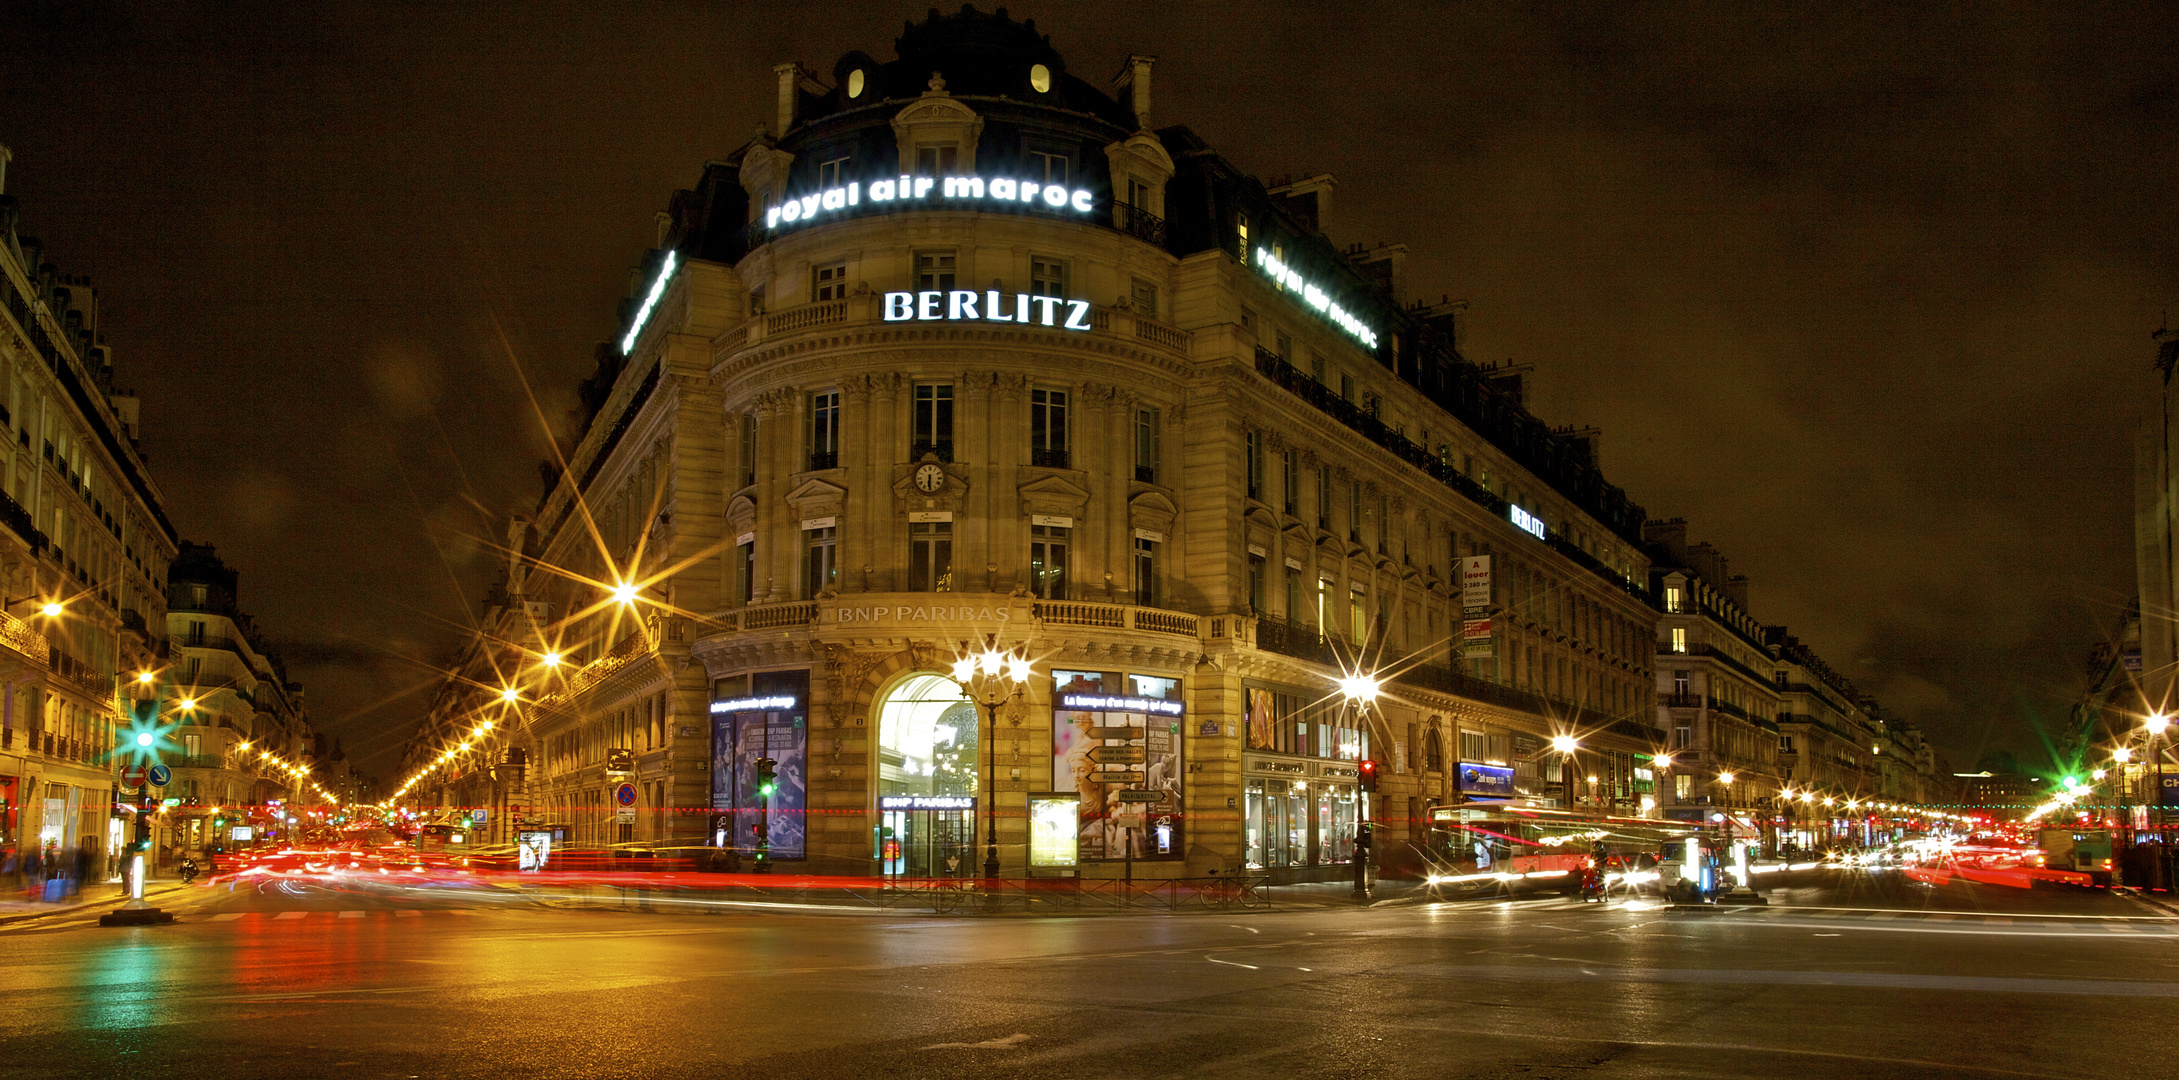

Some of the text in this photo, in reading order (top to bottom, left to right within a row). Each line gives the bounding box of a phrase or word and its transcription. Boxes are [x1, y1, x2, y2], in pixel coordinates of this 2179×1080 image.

[767, 175, 1093, 228] royal air maroc
[1257, 246, 1303, 295] royal
[1330, 302, 1377, 349] maroc
[883, 290, 1091, 331] BERLITZ
[1511, 503, 1545, 540] BERLITZ
[1464, 571, 1489, 579] louer
[838, 606, 1010, 623] BNP PARIBAS
[1463, 606, 1484, 614] CBRE
[1064, 695, 1075, 706] La
[882, 797, 973, 808] BNP PARIBAS
